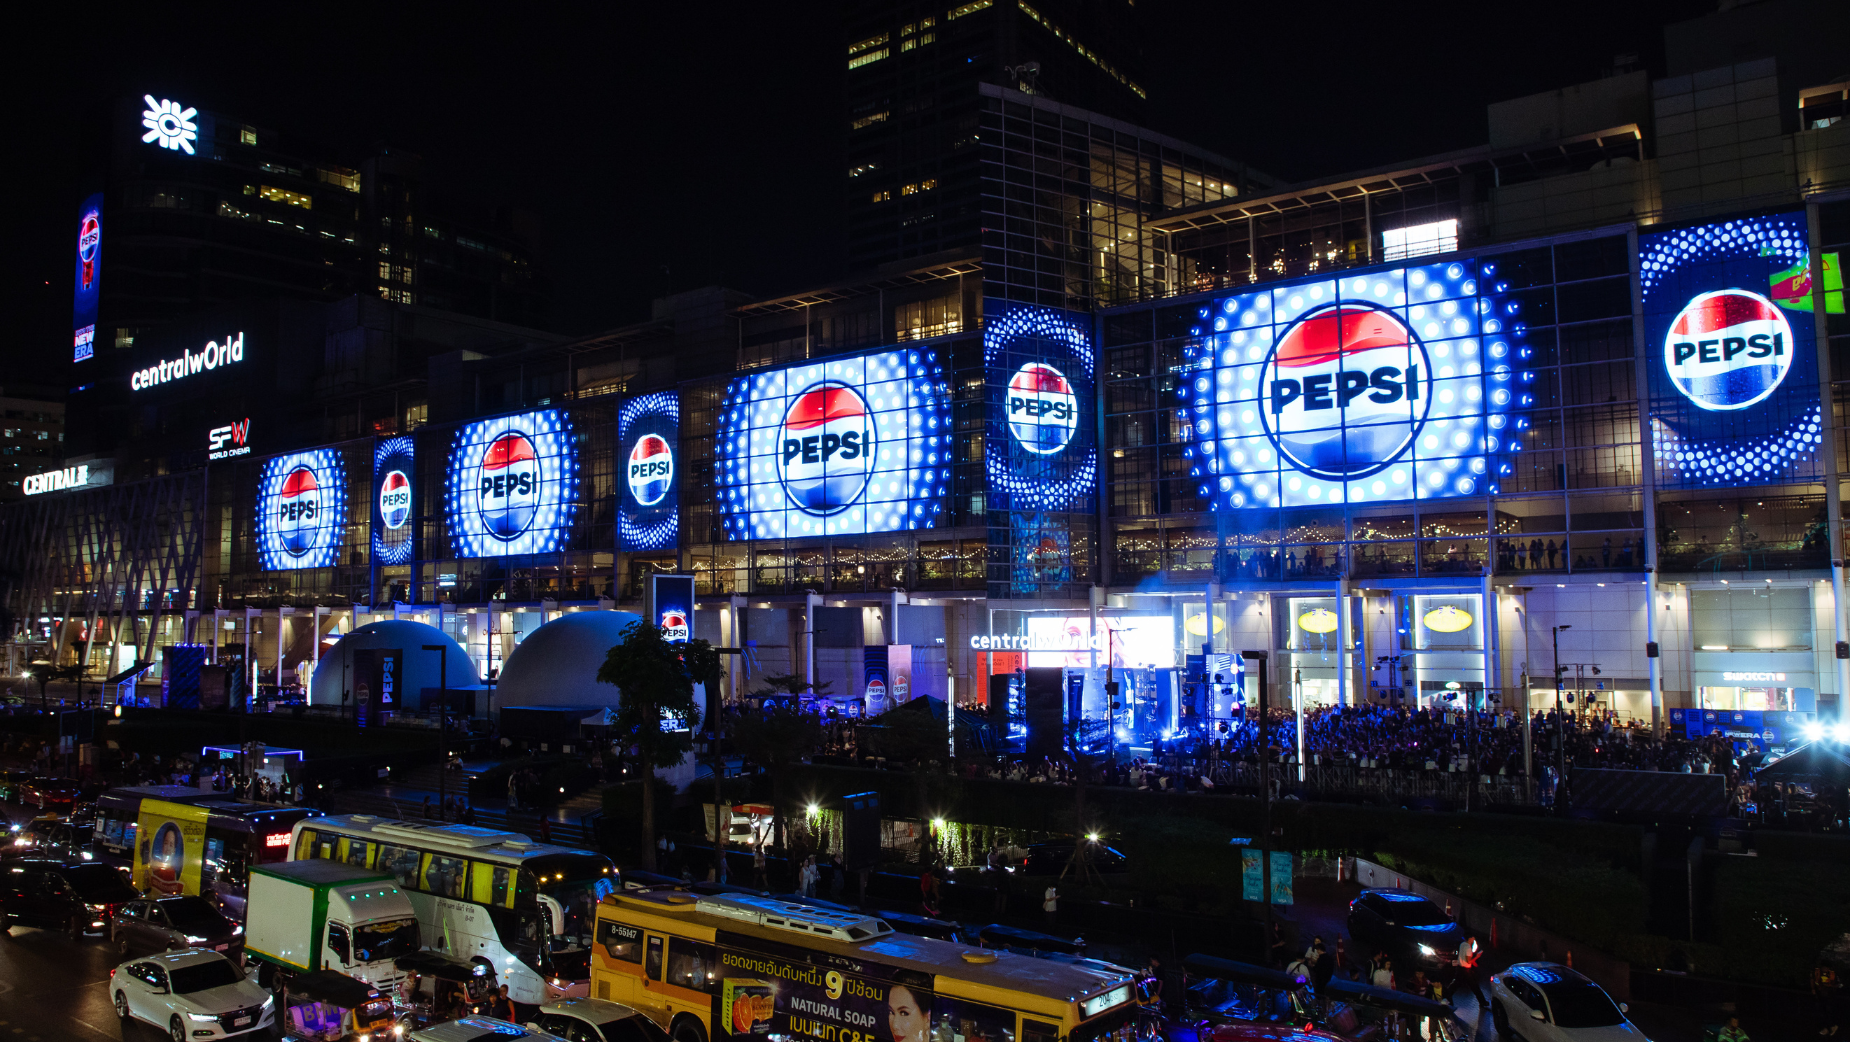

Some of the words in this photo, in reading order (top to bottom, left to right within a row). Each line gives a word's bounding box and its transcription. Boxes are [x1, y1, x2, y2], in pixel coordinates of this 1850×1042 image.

[81, 234, 98, 248] PEPSI
[74, 330, 95, 347] NEW
[74, 342, 94, 359] ERA
[1673, 332, 1784, 366] PEPSI
[1270, 363, 1420, 415] PEPSI
[1010, 396, 1073, 421] PEPSI
[209, 450, 228, 460] WORLD
[229, 446, 251, 457] CINEMA
[782, 430, 870, 466] PEPSI
[23, 467, 79, 496] CENTRAL
[631, 460, 670, 479] PEPSI
[481, 471, 537, 499] PEPSI
[280, 499, 319, 522] PEPSI
[382, 492, 409, 507] PEPSI
[382, 656, 394, 704] PEPSI
[611, 925, 637, 939] 8-55147
[723, 953, 822, 987] ยอดขายอันดับหนึ่ง
[825, 970, 843, 1000] 9
[847, 978, 883, 1001] ปีซ้อน
[1098, 992, 1110, 1007] 204
[791, 996, 841, 1021] NATURAL
[844, 1009, 876, 1028] SOAP
